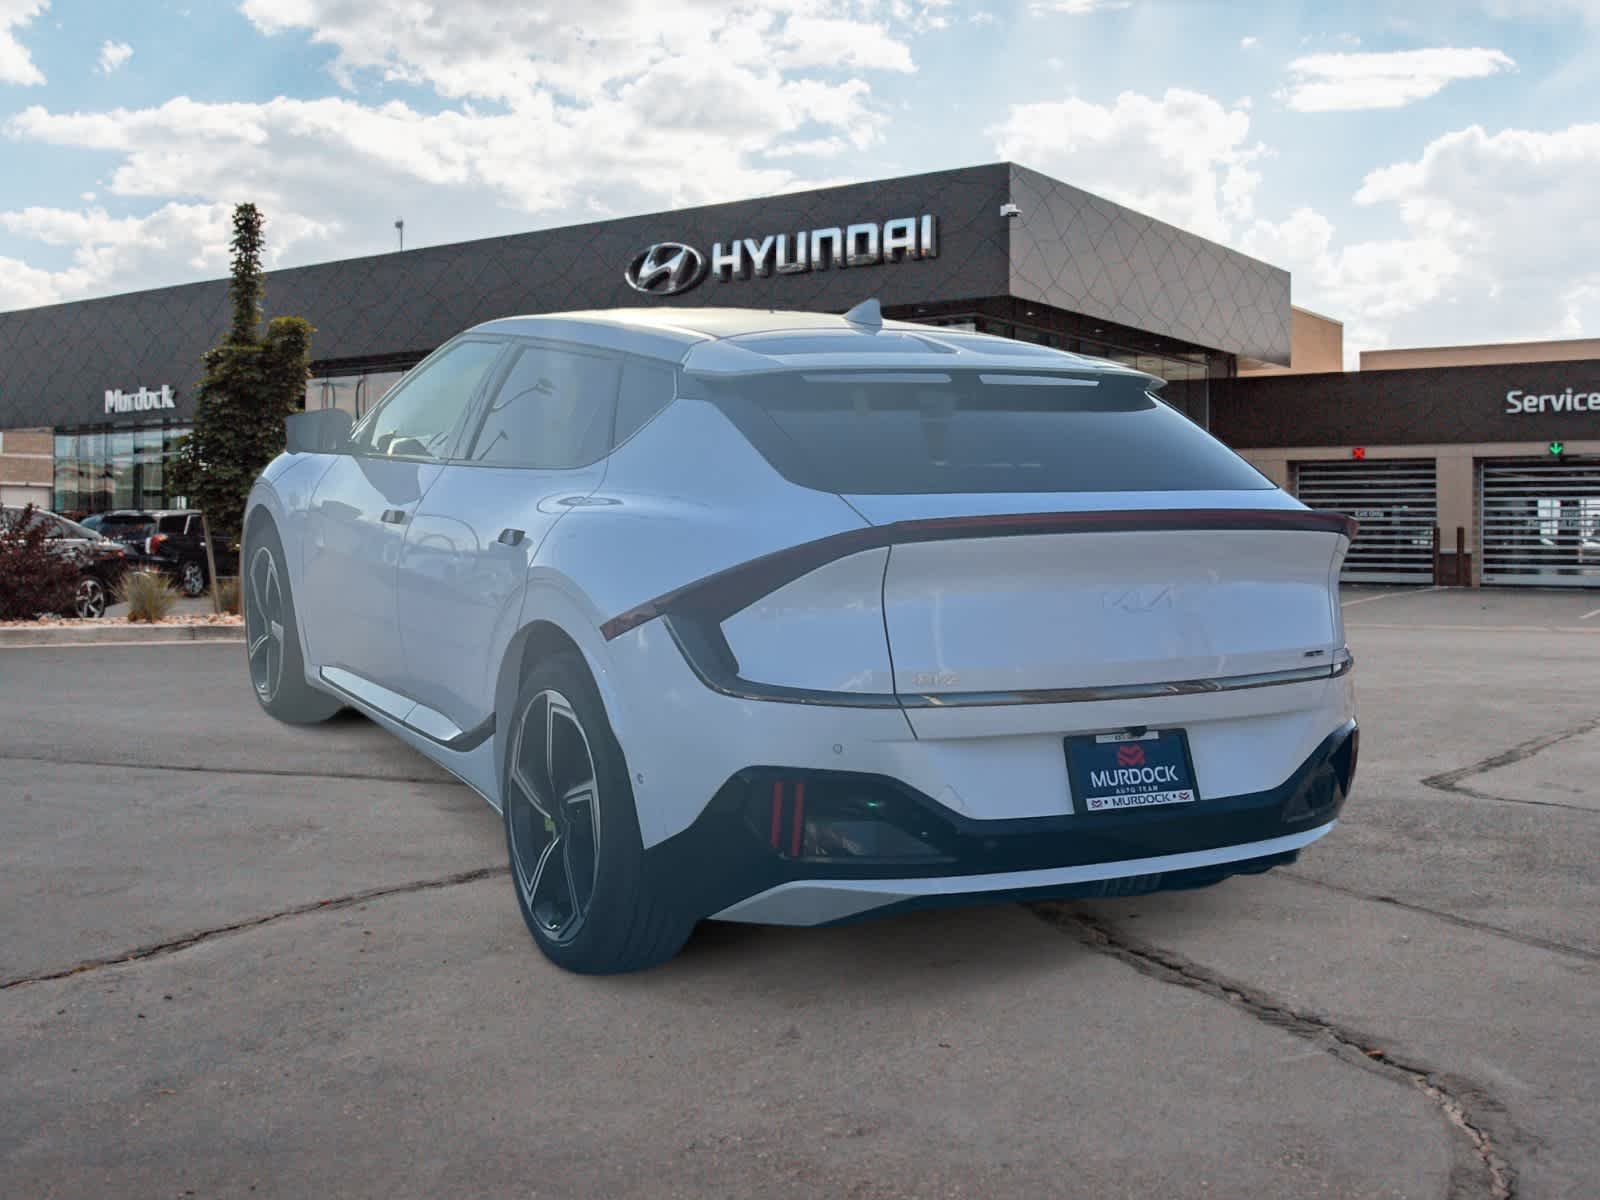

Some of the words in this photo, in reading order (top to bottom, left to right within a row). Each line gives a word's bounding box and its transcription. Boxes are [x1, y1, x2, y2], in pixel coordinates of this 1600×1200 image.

[711, 214, 936, 281] HYUNDAI
[104, 384, 176, 413] Murdock
[1506, 388, 1600, 413] Service
[1090, 765, 1179, 788] MURDOCK
[1112, 793, 1171, 807] MURDOCK
[1115, 785, 1136, 794] AUTO
[1138, 784, 1159, 792] TEAM
